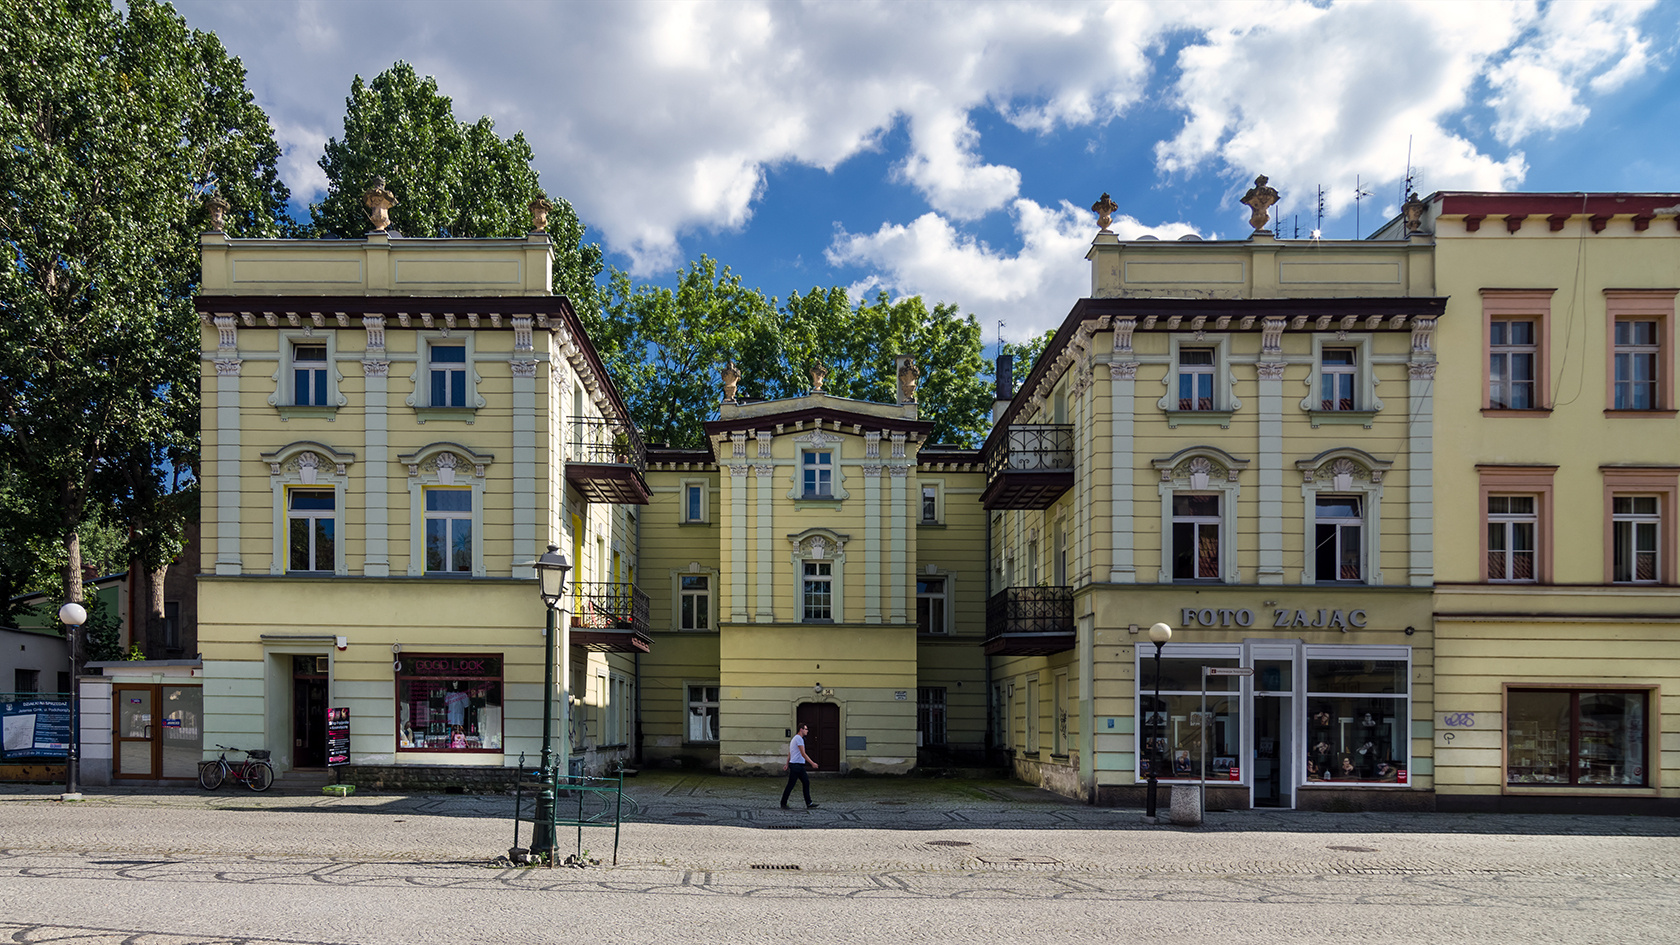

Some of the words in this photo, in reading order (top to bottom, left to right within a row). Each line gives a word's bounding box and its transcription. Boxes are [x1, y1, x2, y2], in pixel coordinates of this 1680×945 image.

[1181, 608, 1255, 627] FOTO
[1273, 609, 1367, 633] ZAJĄC
[415, 660, 449, 670] GOOD
[452, 660, 485, 671] LOOK
